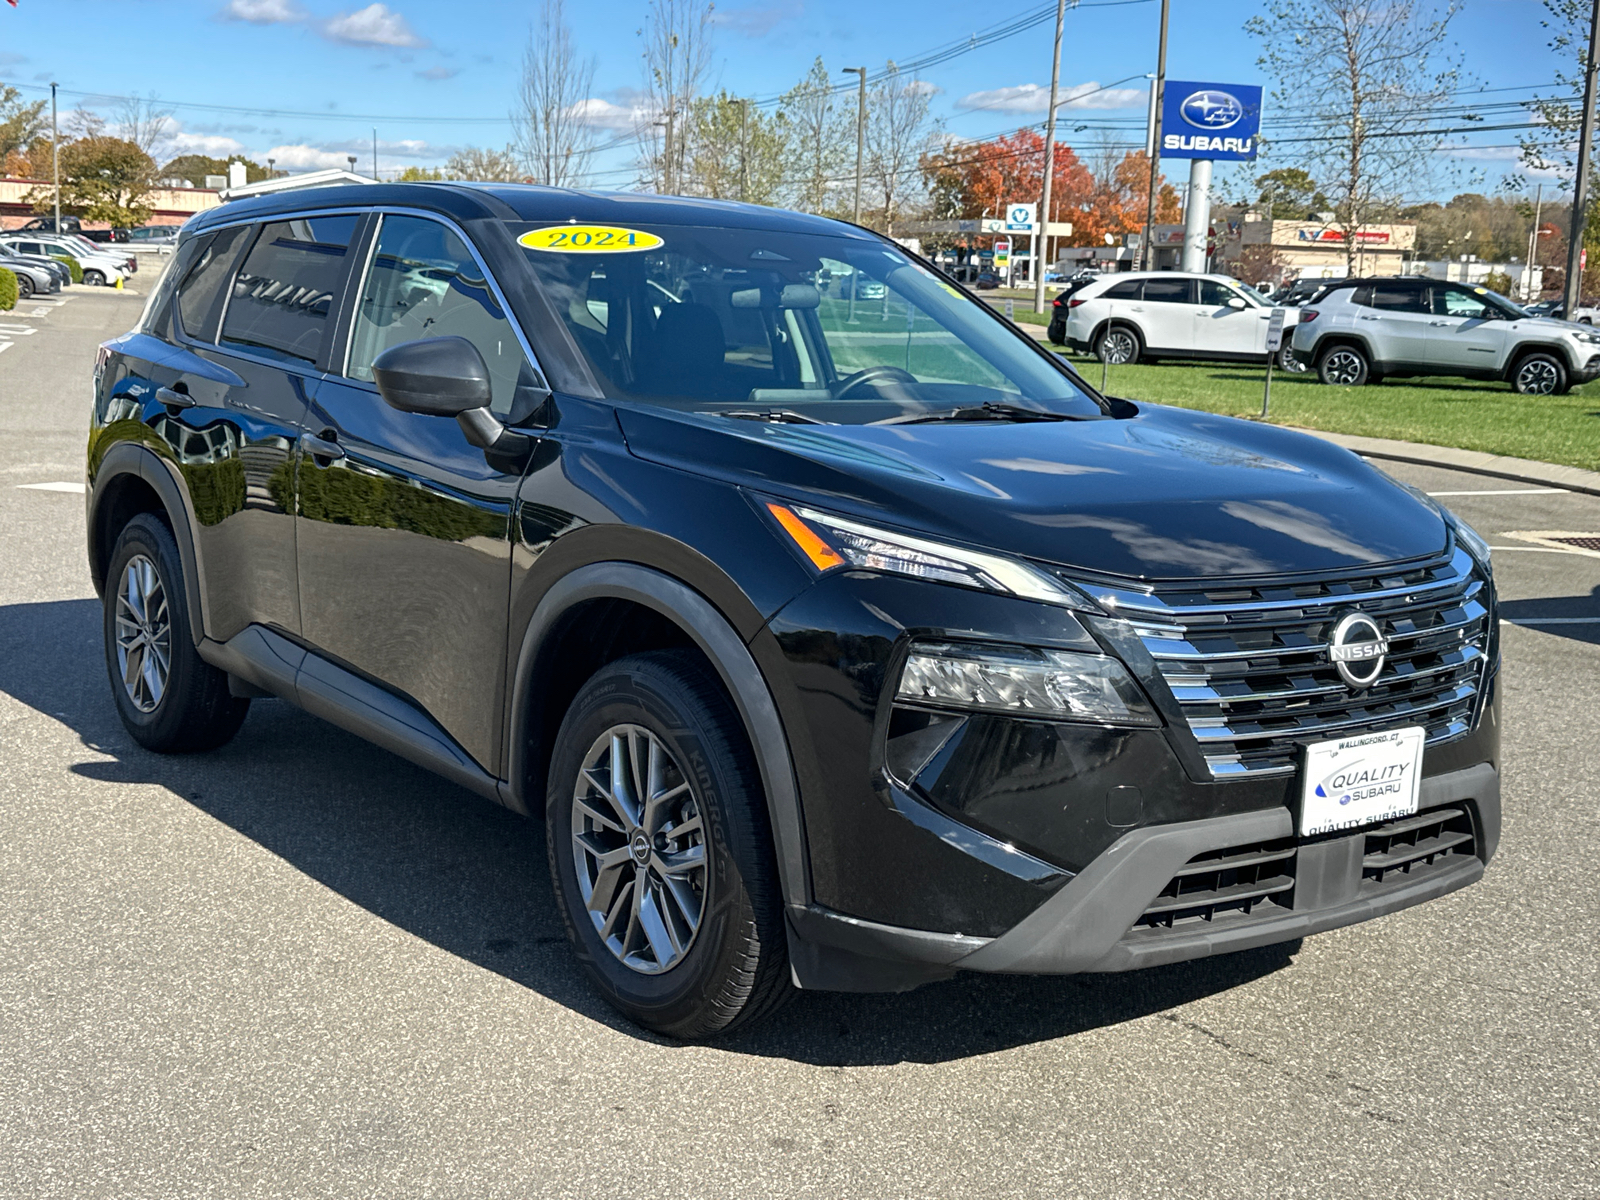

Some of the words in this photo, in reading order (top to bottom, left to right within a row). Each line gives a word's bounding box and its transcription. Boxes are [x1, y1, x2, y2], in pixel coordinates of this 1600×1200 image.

[1164, 134, 1251, 153] SUBARU
[548, 231, 640, 248] 2024
[1332, 642, 1388, 659] NISSAN
[1332, 762, 1410, 788] QUALITY
[1352, 783, 1401, 801] SUBARU
[1309, 818, 1362, 836] QUALITY
[1366, 807, 1414, 824] SUBARU
